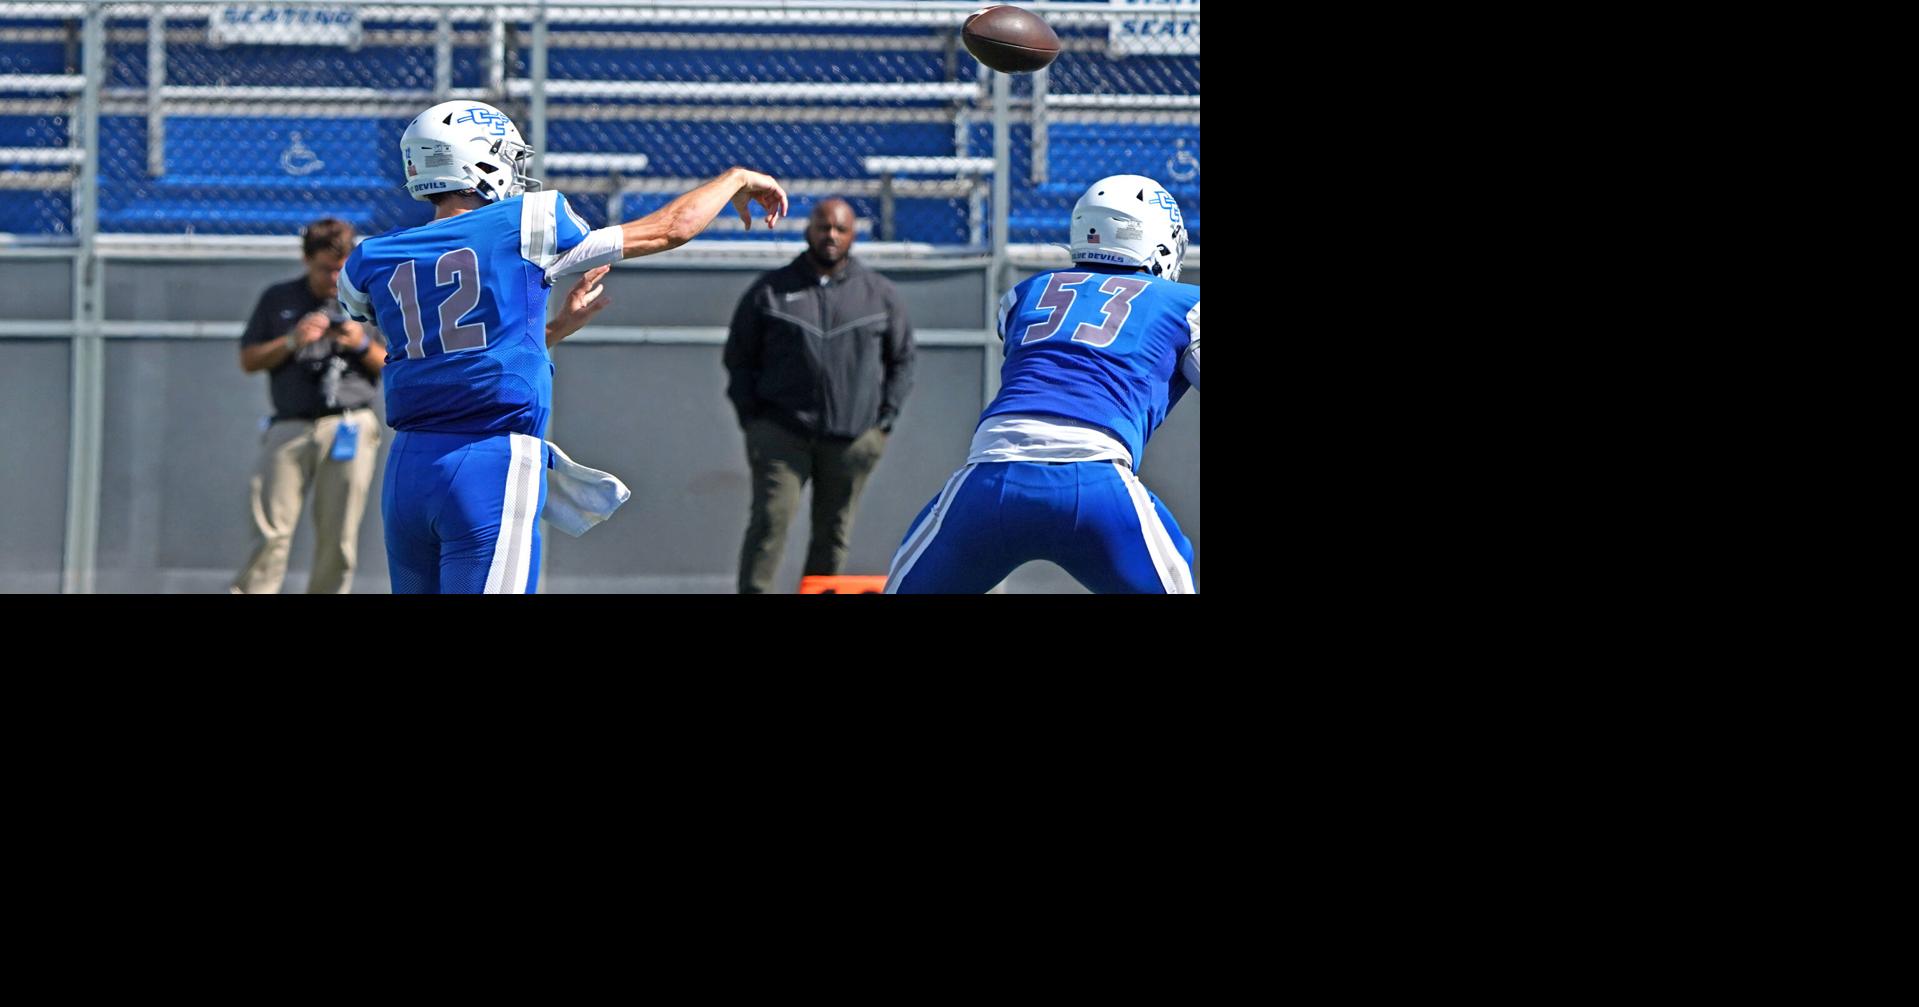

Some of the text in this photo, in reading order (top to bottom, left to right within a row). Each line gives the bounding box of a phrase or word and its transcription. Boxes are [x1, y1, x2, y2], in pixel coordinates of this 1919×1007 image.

[414, 181, 447, 192] DEVILS
[1088, 252, 1124, 263] DEVILS
[387, 247, 487, 359] 12
[1021, 271, 1152, 348] 53
